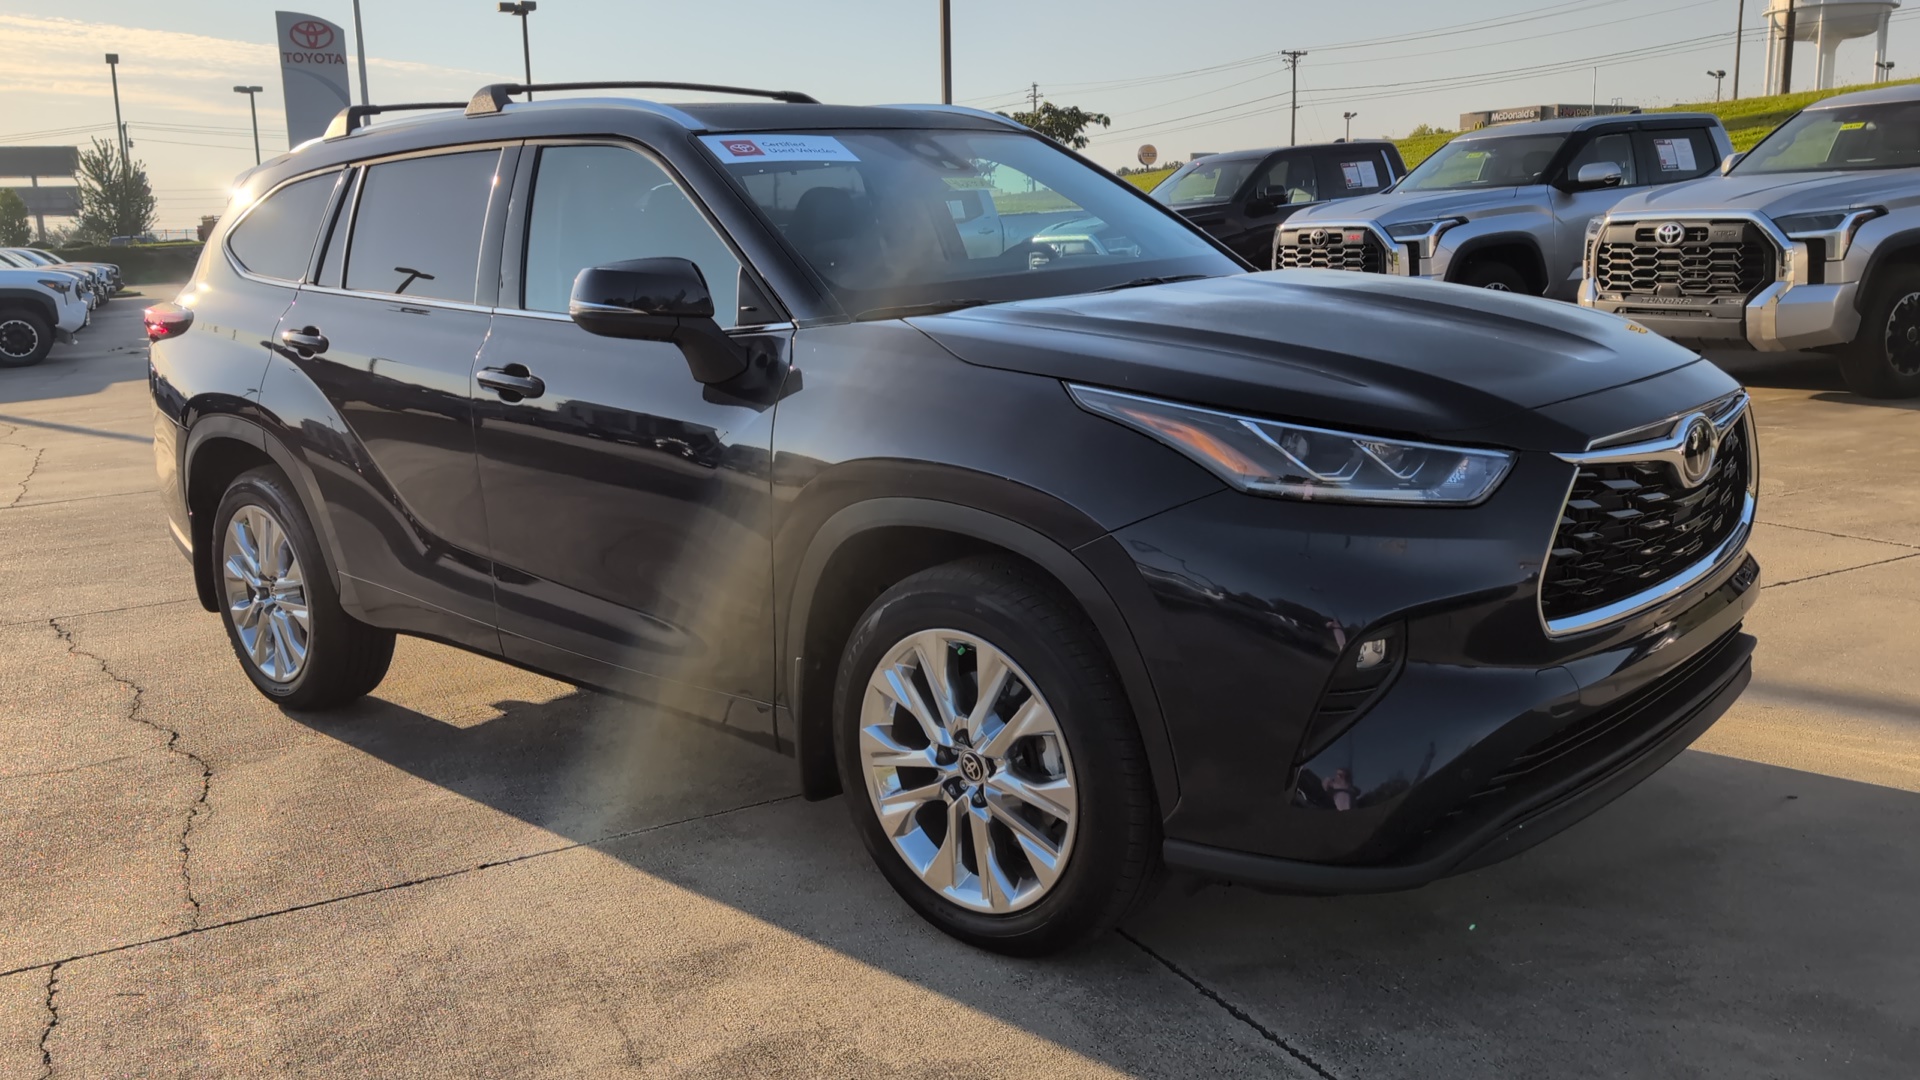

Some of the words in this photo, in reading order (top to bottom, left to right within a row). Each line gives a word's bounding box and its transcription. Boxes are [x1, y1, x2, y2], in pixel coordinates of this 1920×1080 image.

[283, 52, 345, 64] TOYOTA
[1491, 110, 1535, 122] McDonald's
[1640, 297, 1692, 305] TUNDRA
